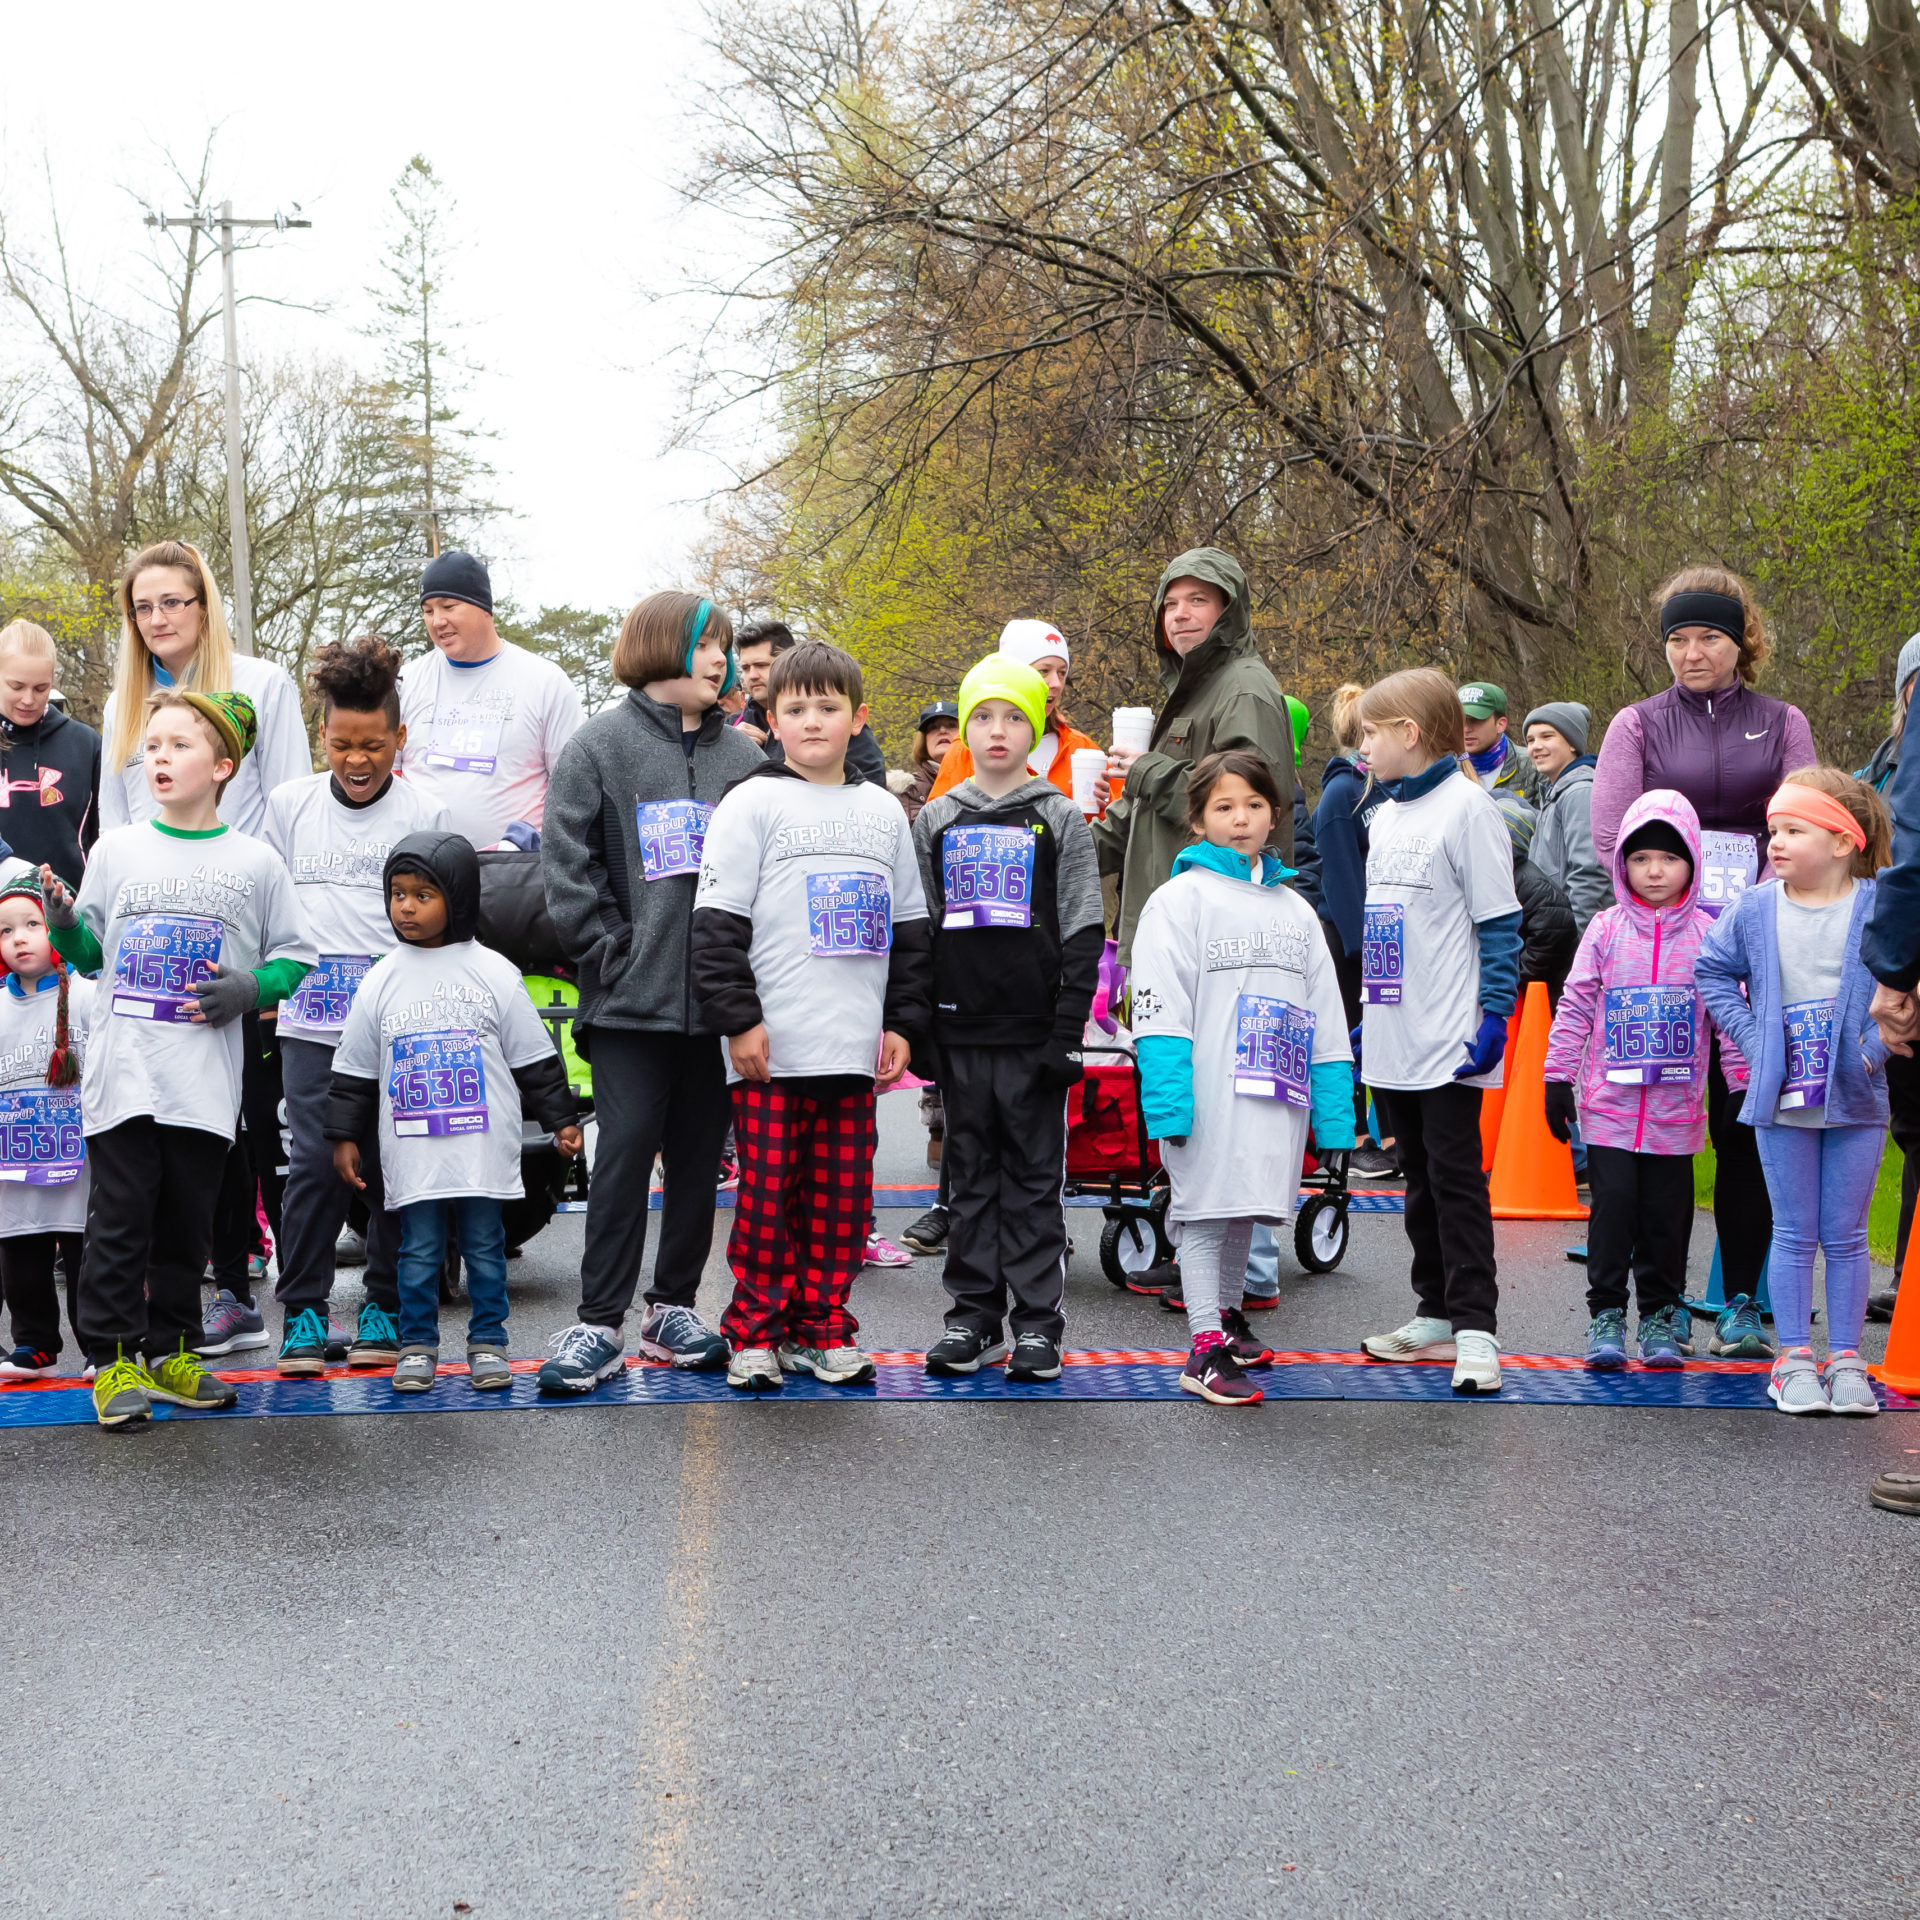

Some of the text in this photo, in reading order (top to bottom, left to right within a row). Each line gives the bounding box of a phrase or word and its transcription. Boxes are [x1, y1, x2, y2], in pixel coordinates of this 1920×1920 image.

[450, 729, 484, 754] 45
[641, 822, 670, 837] STEP
[670, 816, 687, 829] UP
[687, 807, 695, 818] 4
[775, 808, 899, 848] STEP UP 4 KIDS
[293, 855, 319, 874] TEP
[319, 851, 344, 870] UP
[344, 838, 358, 855] 4
[645, 832, 705, 871] 153
[945, 833, 1025, 864] STEP UP 4 KIDS
[1714, 841, 1721, 851] 4
[1725, 842, 1750, 853] KIDS
[118, 864, 256, 906] STEP UP 4 KIDS
[947, 862, 1026, 902] 1536
[1699, 866, 1747, 900] 53
[811, 896, 842, 910] STEP
[841, 892, 859, 905] UP
[814, 909, 889, 950] 1536
[1375, 913, 1396, 925] KIDS
[123, 926, 214, 950] STEP UP 4 KIDS
[1206, 938, 1250, 960] STEP
[1250, 931, 1271, 951] UP
[301, 976, 315, 989] TEP
[314, 974, 329, 986] UP
[330, 963, 339, 975] 4
[292, 990, 351, 1025] 153
[381, 981, 494, 1037] STEP UP 4 KIDS
[1240, 1016, 1270, 1031] STEP
[1608, 993, 1688, 1023] STEP UP 4 KIDS
[1804, 1010, 1813, 1022] 4
[14, 1044, 33, 1064] UP
[34, 1025, 48, 1043] 4
[1609, 1020, 1691, 1059] 1536
[394, 1040, 472, 1073] STEP UP 4 KIDS
[1241, 1031, 1308, 1082] 1536
[1661, 1067, 1690, 1075] GEICO
[1789, 1038, 1830, 1080] 53
[392, 1067, 480, 1109] 1536
[20, 1108, 35, 1120] UP
[35, 1097, 44, 1109] 4
[47, 1097, 77, 1109] KIDS
[448, 1115, 484, 1125] GEICO
[0, 1124, 81, 1160] 1536
[47, 1169, 78, 1178] GEICO
